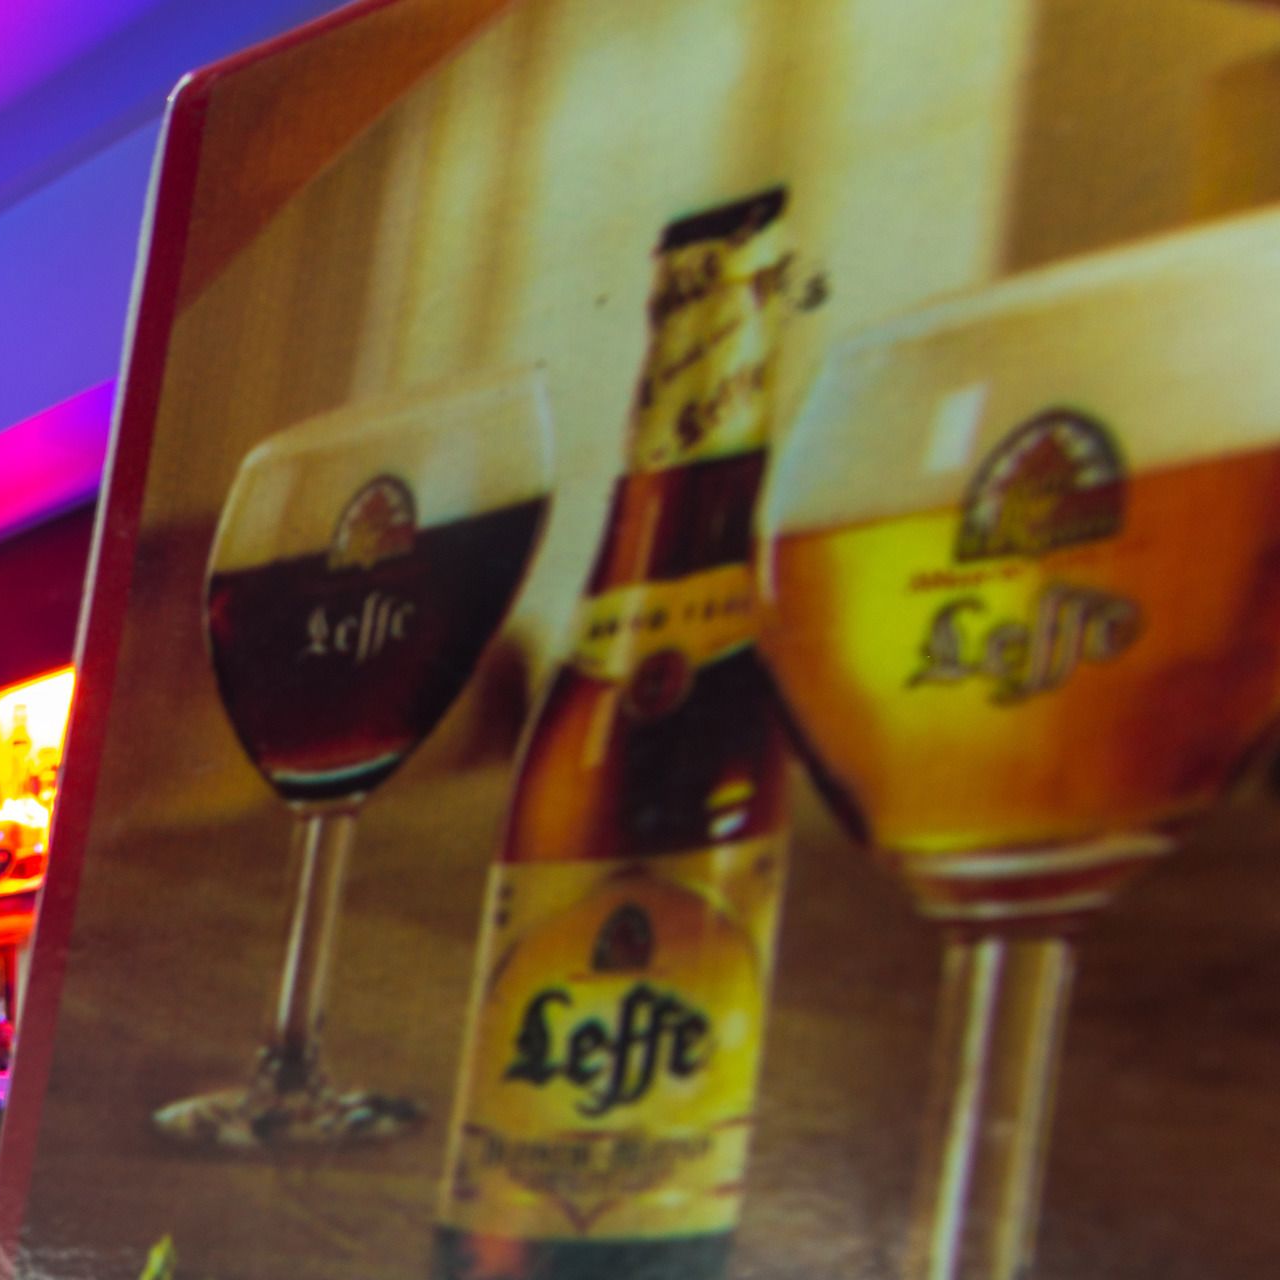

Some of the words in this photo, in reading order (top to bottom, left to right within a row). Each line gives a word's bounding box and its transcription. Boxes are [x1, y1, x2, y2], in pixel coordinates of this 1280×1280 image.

[299, 591, 416, 664] Leffe
[903, 582, 1145, 707] Leffe
[503, 982, 710, 1118] Leffe
